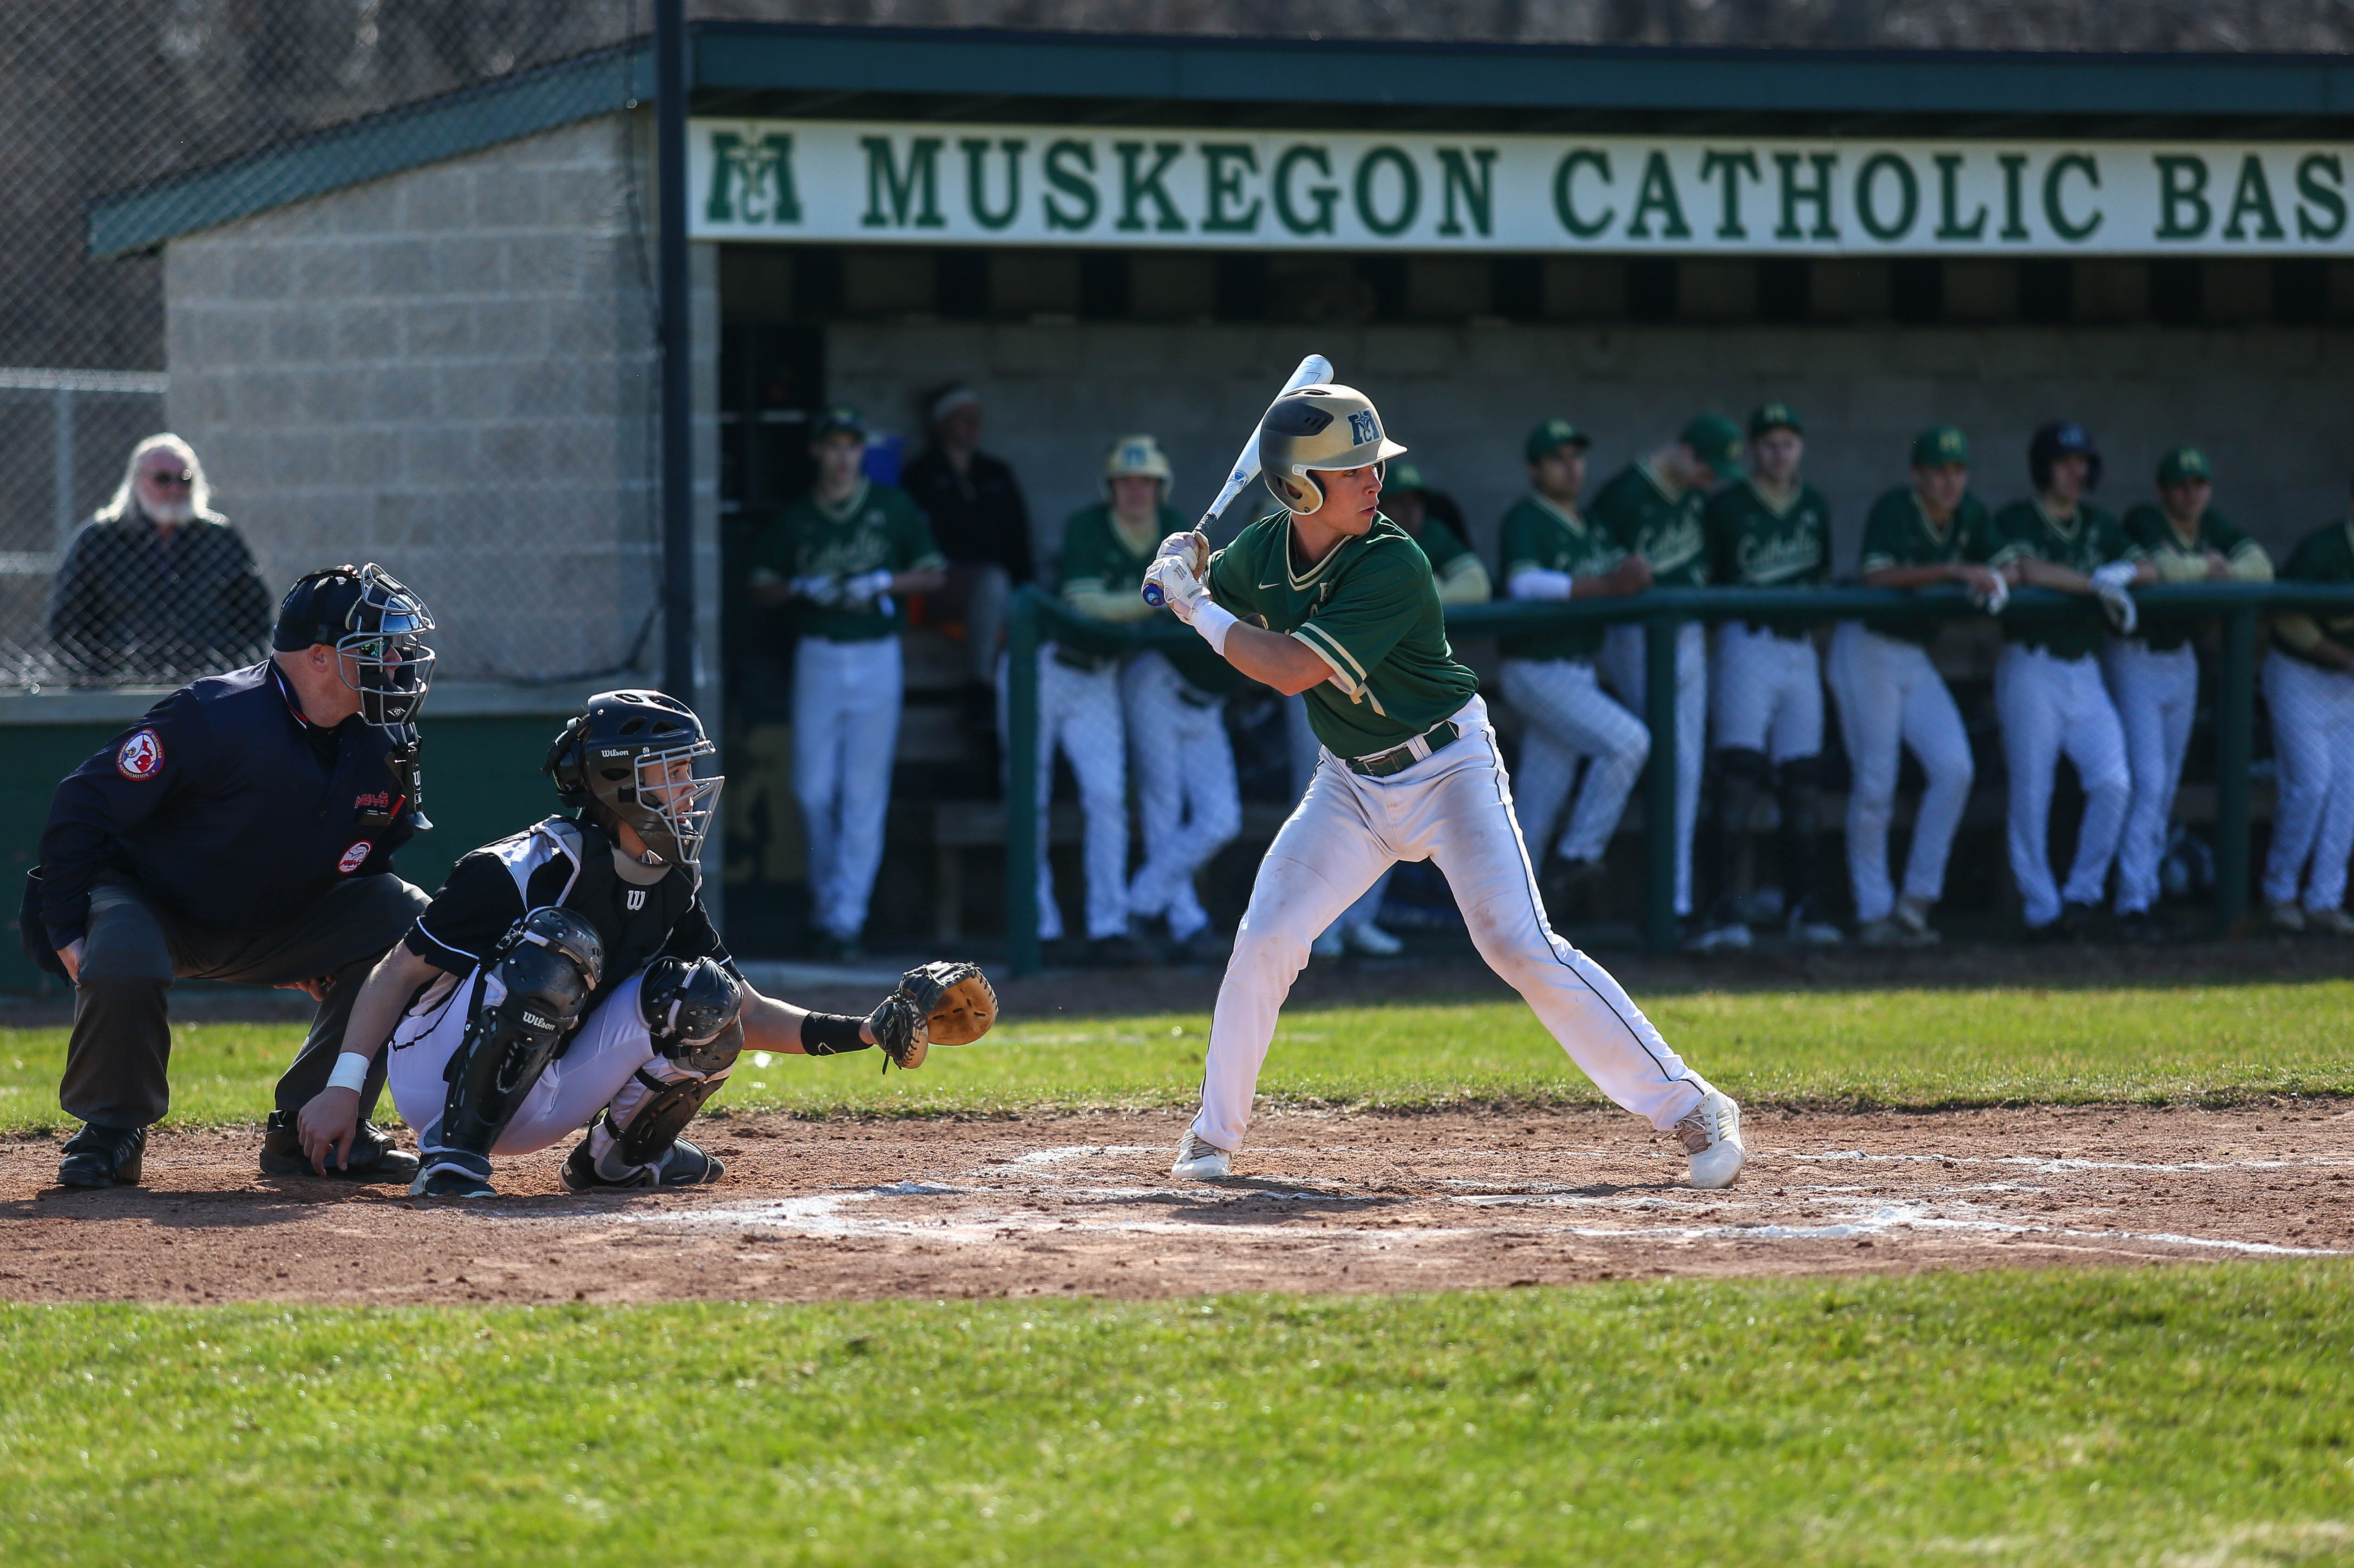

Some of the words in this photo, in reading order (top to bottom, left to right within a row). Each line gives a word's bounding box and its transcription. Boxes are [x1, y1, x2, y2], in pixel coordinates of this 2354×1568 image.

[858, 134, 1499, 238] MUSKEGON
[1552, 146, 2104, 244] CATHOLIC
[2151, 151, 2348, 243] BAS
[601, 749, 629, 758] Wilson
[119, 764, 149, 778] ASSOCIATION
[627, 890, 646, 910] W
[523, 1011, 556, 1031] Wilson
